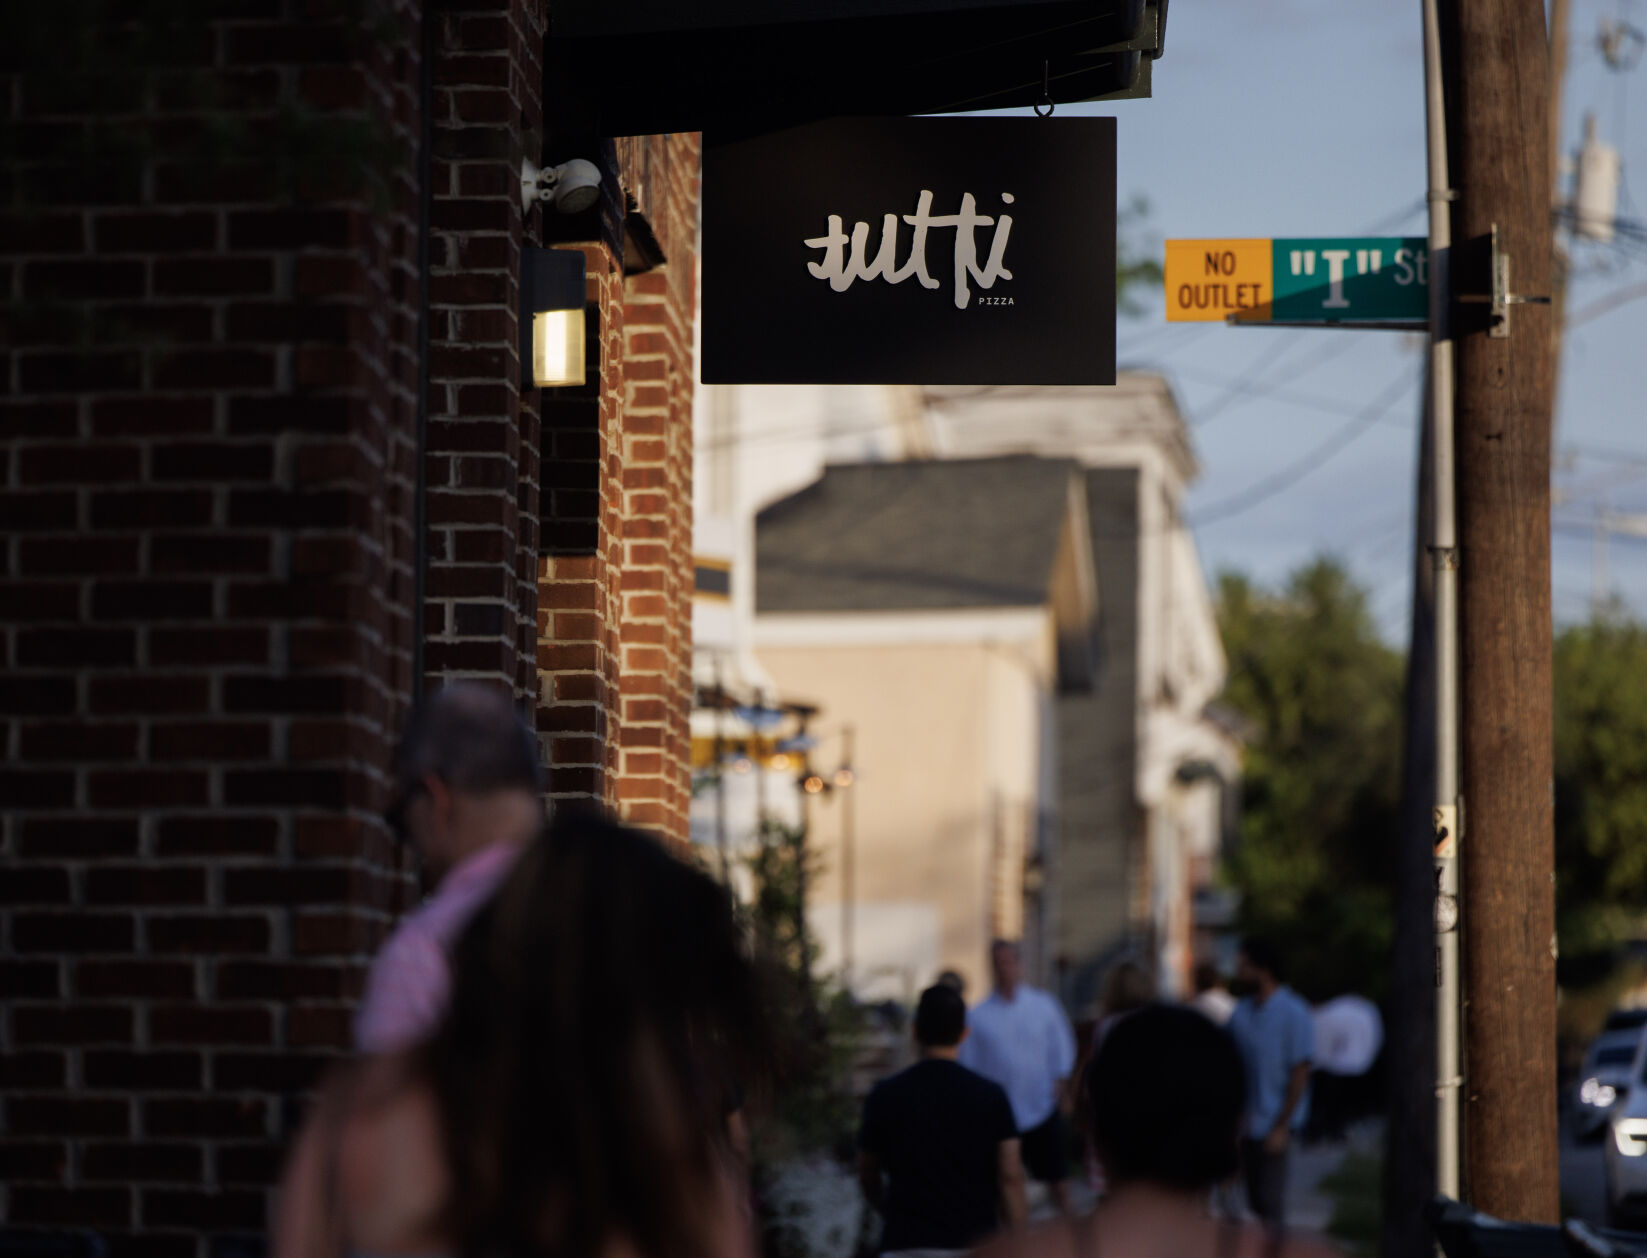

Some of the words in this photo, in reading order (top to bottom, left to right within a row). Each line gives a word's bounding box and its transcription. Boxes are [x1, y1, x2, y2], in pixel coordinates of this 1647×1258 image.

[804, 189, 1015, 310] tutti
[1205, 251, 1236, 276] NO
[1394, 248, 1428, 286] St
[978, 297, 1015, 306] PIZZA
[1178, 284, 1262, 309] OUTLET
